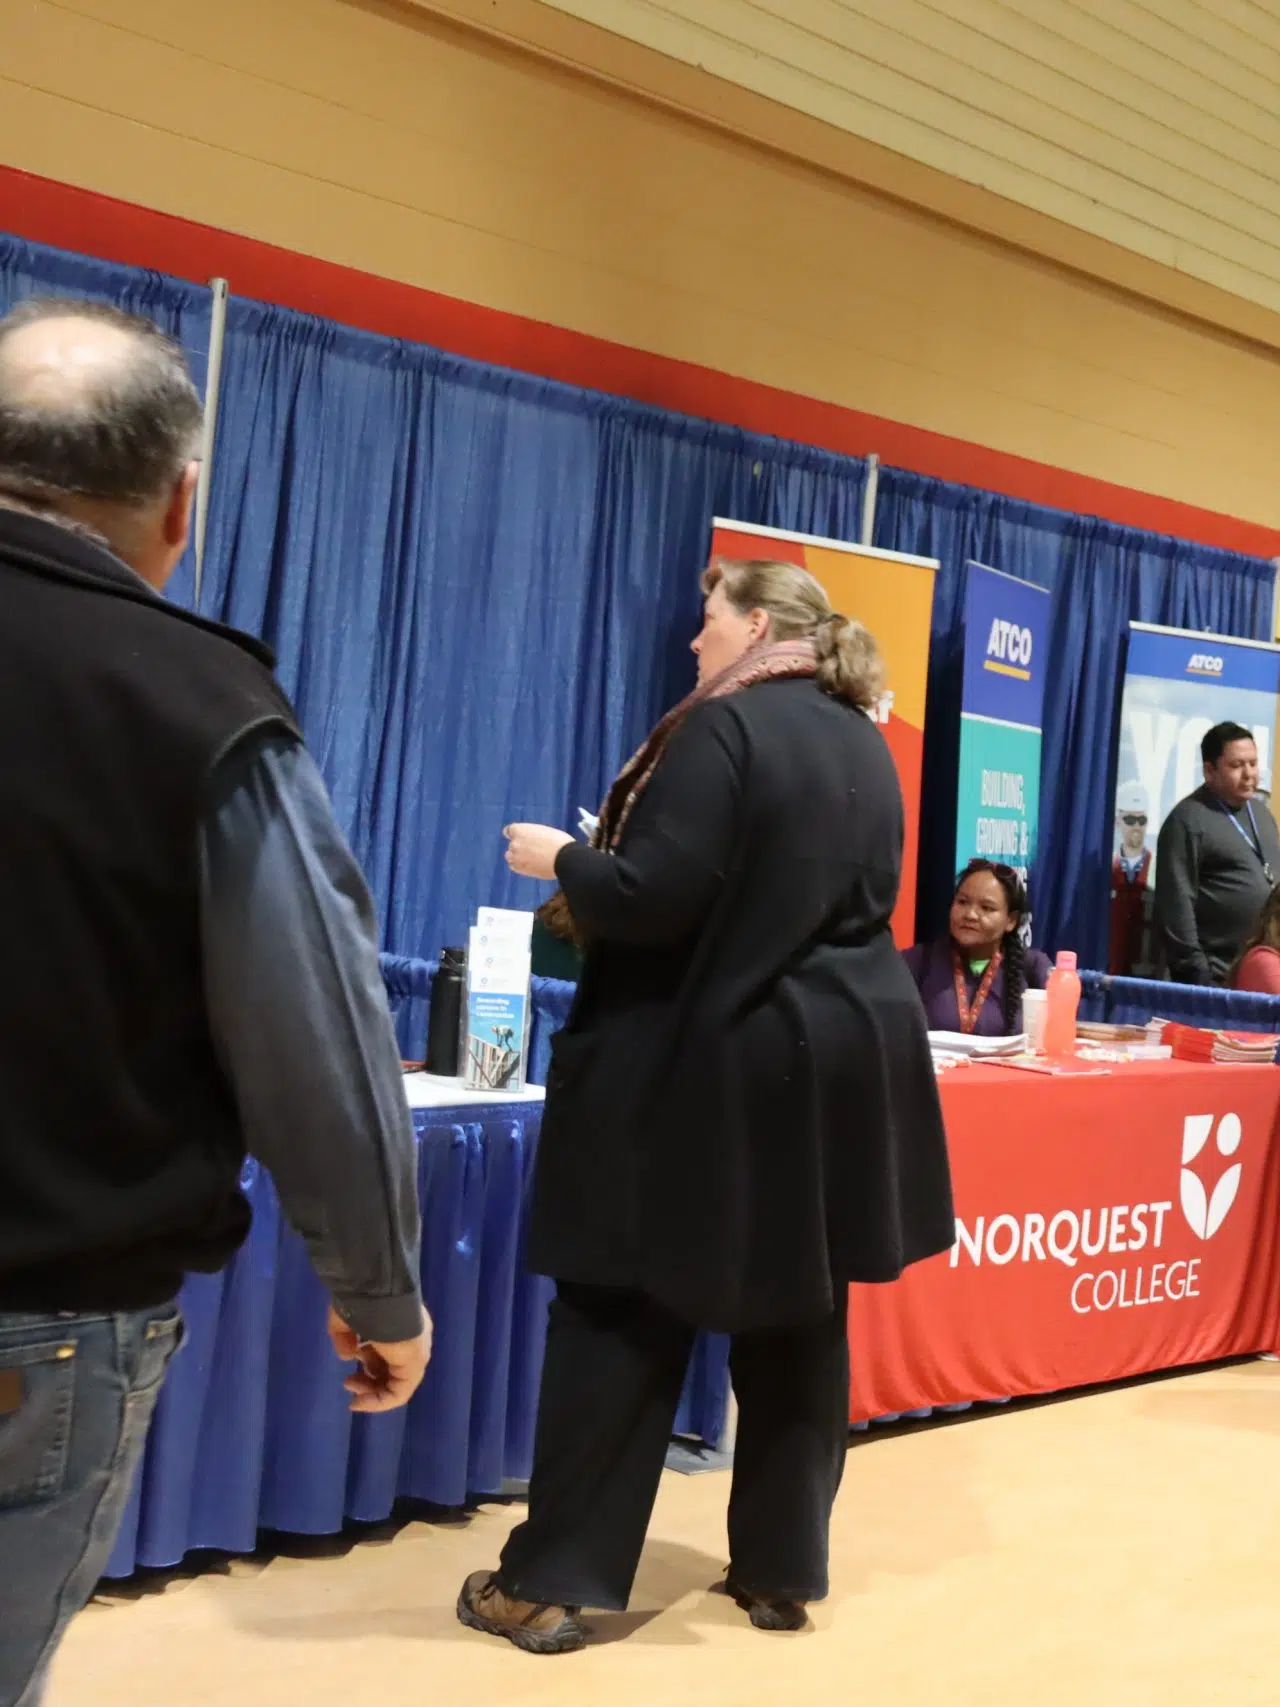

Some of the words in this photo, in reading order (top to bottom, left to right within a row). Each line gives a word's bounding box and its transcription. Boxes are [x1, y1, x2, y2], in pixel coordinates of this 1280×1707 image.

[986, 617, 1032, 666] ATCO
[1188, 653, 1223, 672] ATCO
[976, 816, 1018, 855] GROWING
[1020, 820, 1029, 856] &
[949, 1200, 1172, 1268] NORQUEST
[1070, 1258, 1201, 1314] COLLEGE
